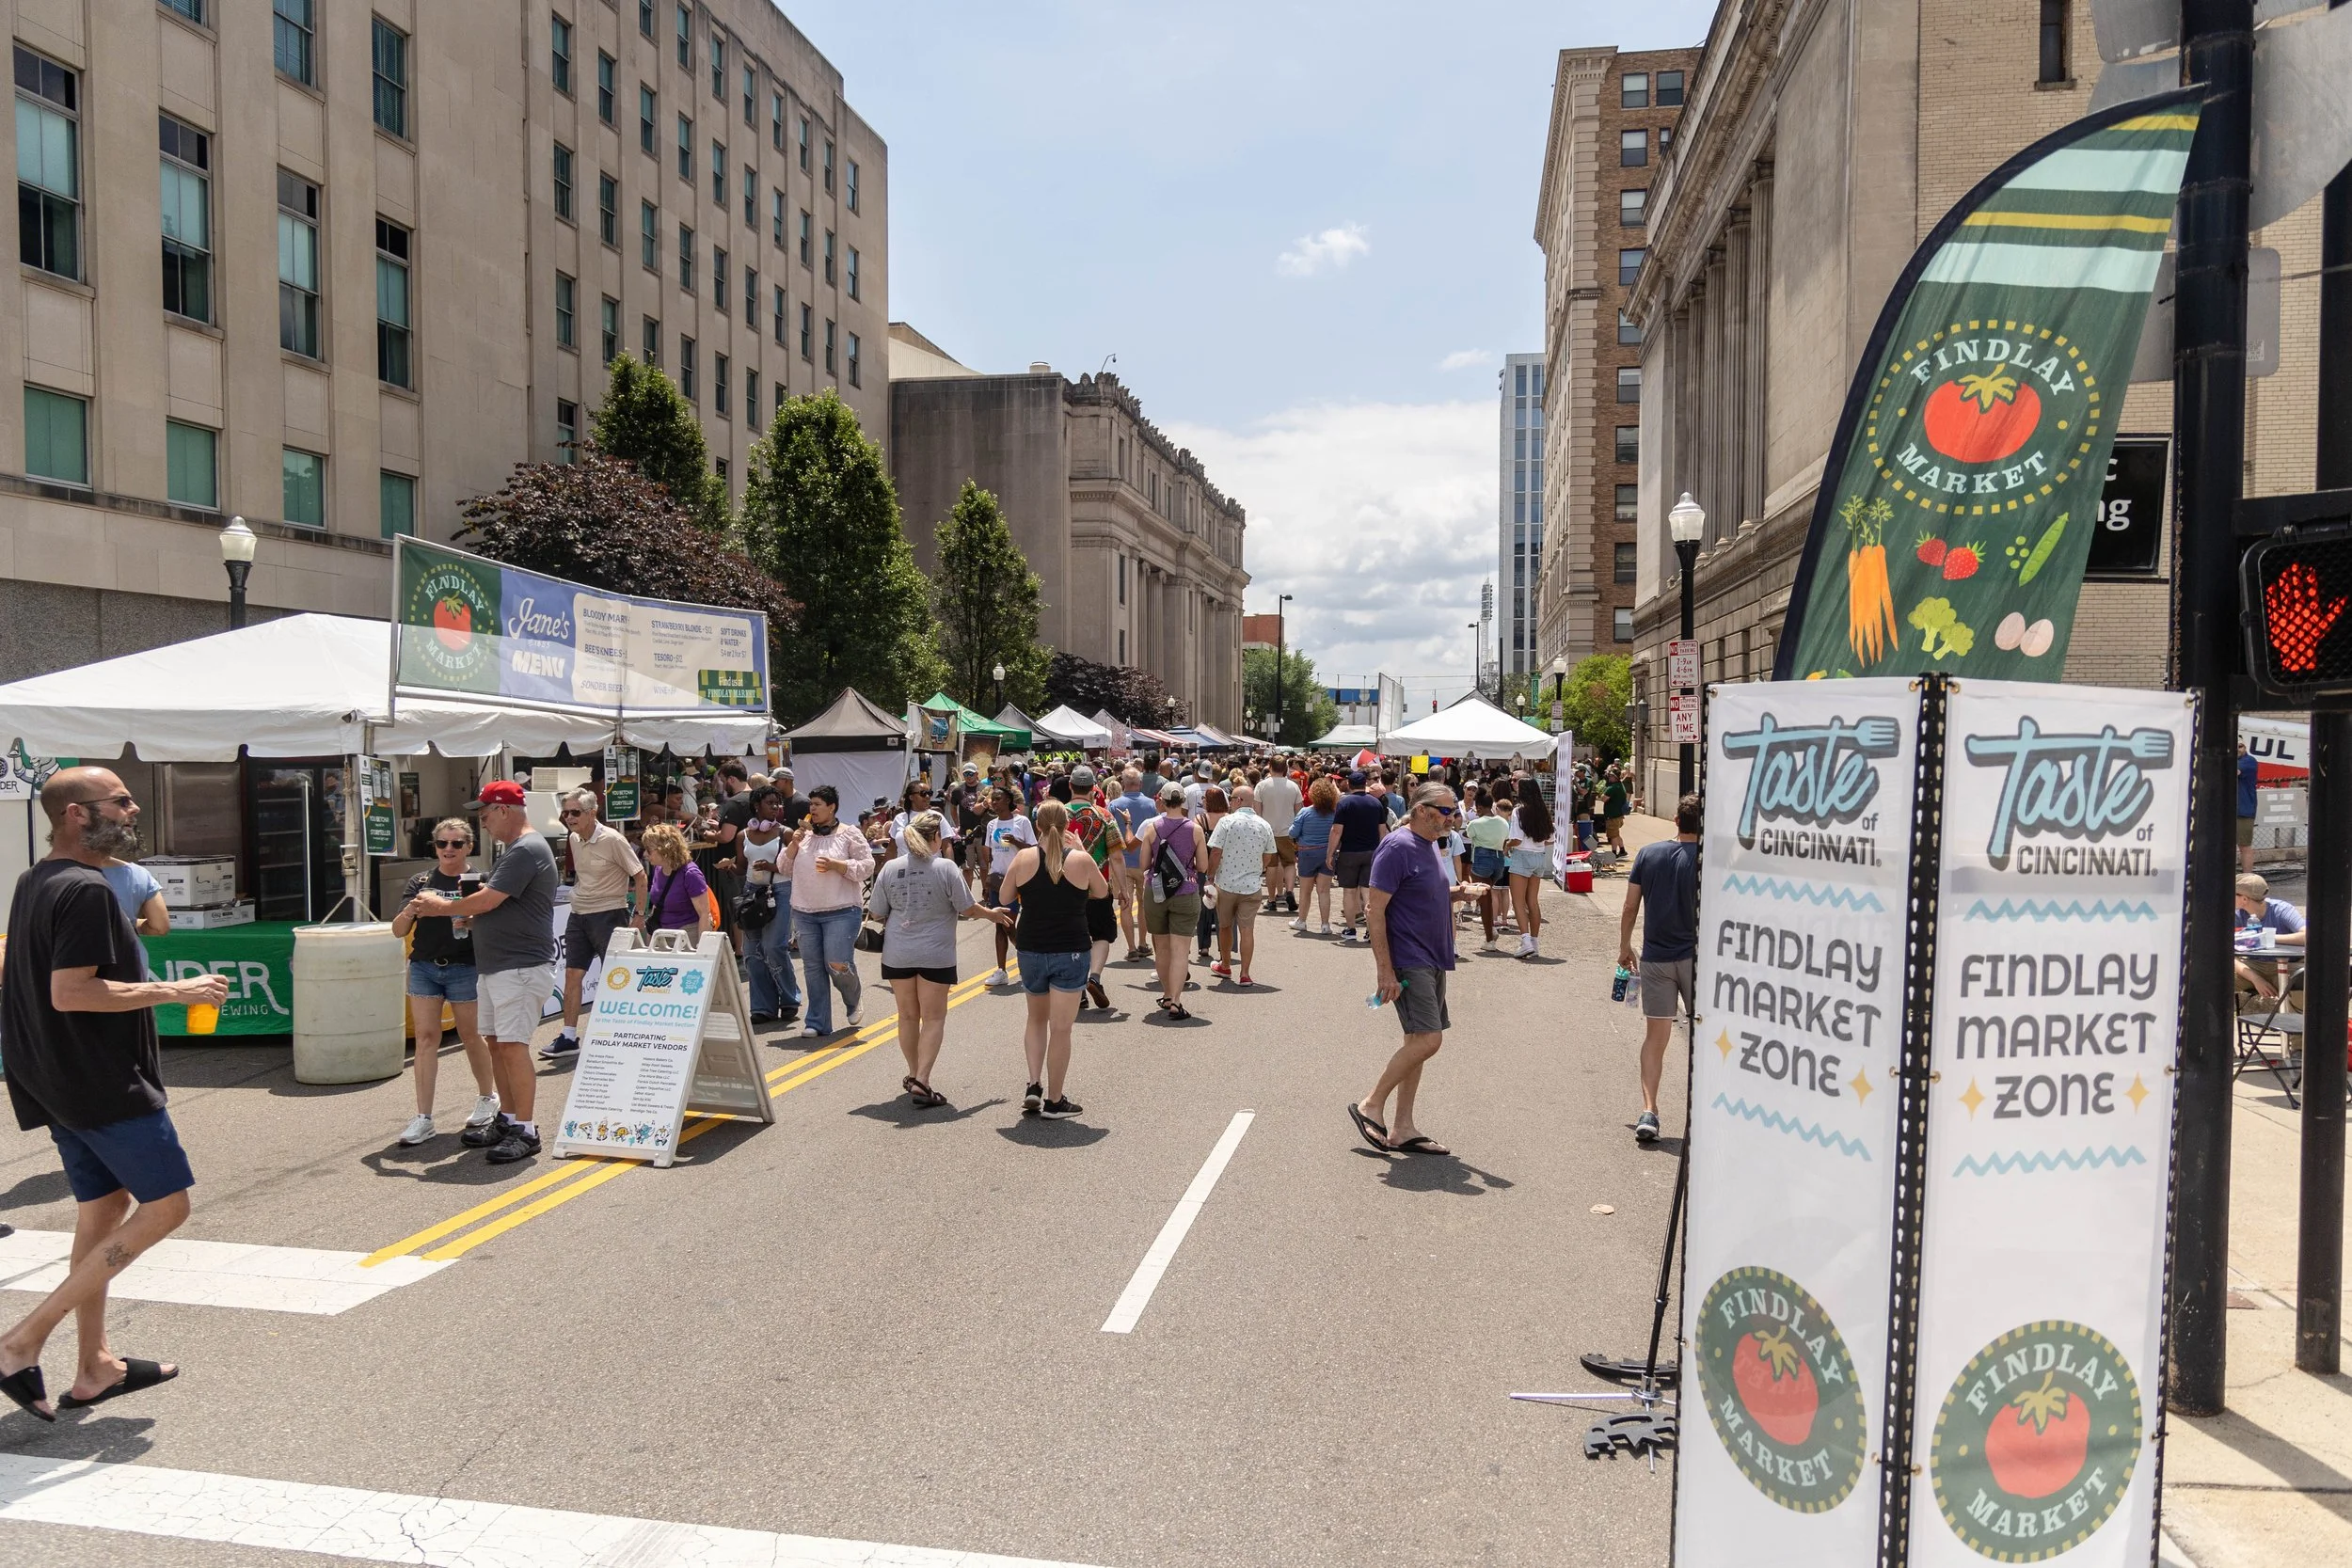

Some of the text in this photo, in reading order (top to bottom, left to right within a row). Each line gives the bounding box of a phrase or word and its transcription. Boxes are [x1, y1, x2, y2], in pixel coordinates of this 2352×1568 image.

[1910, 338, 2075, 398] FINDLAY
[1896, 443, 2048, 495] MARKET
[425, 575, 485, 611] FINDLAY
[508, 597, 570, 640] Jane's
[582, 608, 607, 621] BLOODY
[651, 620, 684, 631] STRAWBERRY
[685, 623, 702, 633] BLONDE
[720, 627, 747, 638] SOFT DRINKS
[426, 638, 481, 670] MARKET
[723, 639, 739, 647] WATER
[1670, 645, 1678, 654] NO
[512, 650, 565, 678] MENU
[1676, 713, 1692, 721] ANY
[1676, 723, 1694, 733] TIME
[1722, 712, 1900, 849] Taste
[1964, 715, 2175, 871] Taste
[1862, 813, 1879, 832] of
[2137, 823, 2154, 842] of
[1716, 919, 1883, 993] FINDLAY
[636, 966, 678, 991] Taste
[1960, 952, 2159, 1001] FINDLAY
[599, 1001, 699, 1019] WELCOME!
[1713, 971, 1883, 1048] MARKET
[613, 1032, 666, 1041] PARTICIPATING
[653, 1043, 688, 1052] VENDORS
[1956, 1012, 2158, 1060] MARKET
[1739, 1031, 1841, 1098] ZONE
[1993, 1071, 2116, 1120] ZONE
[1719, 1288, 1844, 1386] FINDLAY
[1965, 1342, 2119, 1417] FINDLAY
[1720, 1394, 1834, 1487] MARKET
[1966, 1466, 2107, 1540] MARKET
